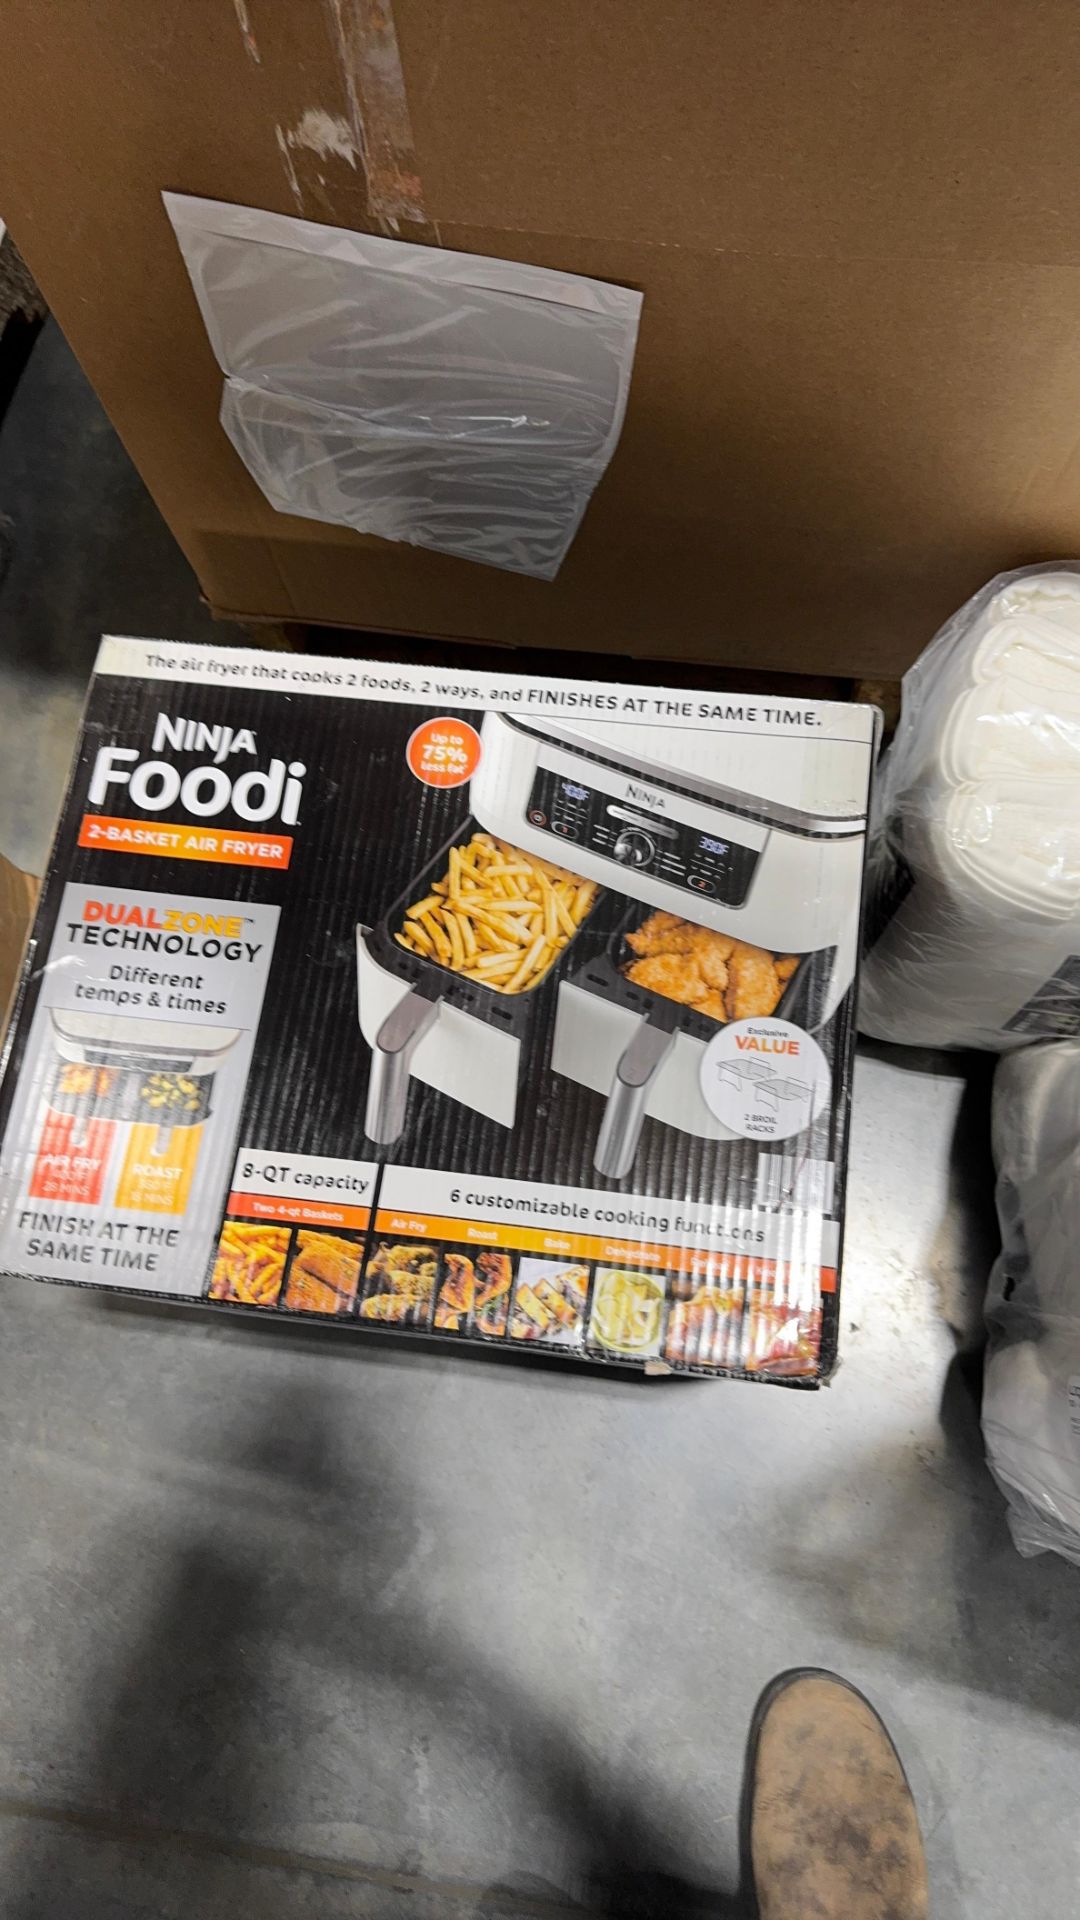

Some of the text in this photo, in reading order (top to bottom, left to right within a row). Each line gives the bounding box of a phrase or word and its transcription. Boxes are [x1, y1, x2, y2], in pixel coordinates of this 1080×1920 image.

[146, 654, 822, 726] The air fryer that cooks 2 foods, 2 ways, and FINISHES AT THE SAME TIME.
[151, 712, 258, 764] NINJA
[431, 733, 464, 745] Up to
[423, 744, 468, 763] 75%
[421, 761, 445, 772] less
[87, 745, 307, 826] Foodi
[625, 783, 665, 808] NINJA
[88, 824, 284, 859] 2-BASKET AIR FRYER
[67, 923, 262, 963] TECHNOLOGY
[109, 964, 204, 989] Different
[75, 983, 227, 1014] temps & times
[747, 1027, 789, 1038] Exclusive
[735, 1035, 800, 1056] VALUE
[752, 1115, 778, 1125] BROIL
[132, 1164, 183, 1180] ROAST
[242, 1163, 370, 1194] 8-QT capacity
[252, 1202, 276, 1214] Two
[302, 1208, 344, 1222] Baskets
[450, 1189, 766, 1242] 6 customizable cooking functons
[17, 1211, 180, 1247] FINISH AT THE
[391, 1218, 428, 1233] Air Fry
[467, 1228, 497, 1241] Roast
[27, 1238, 160, 1271] SAME TIME
